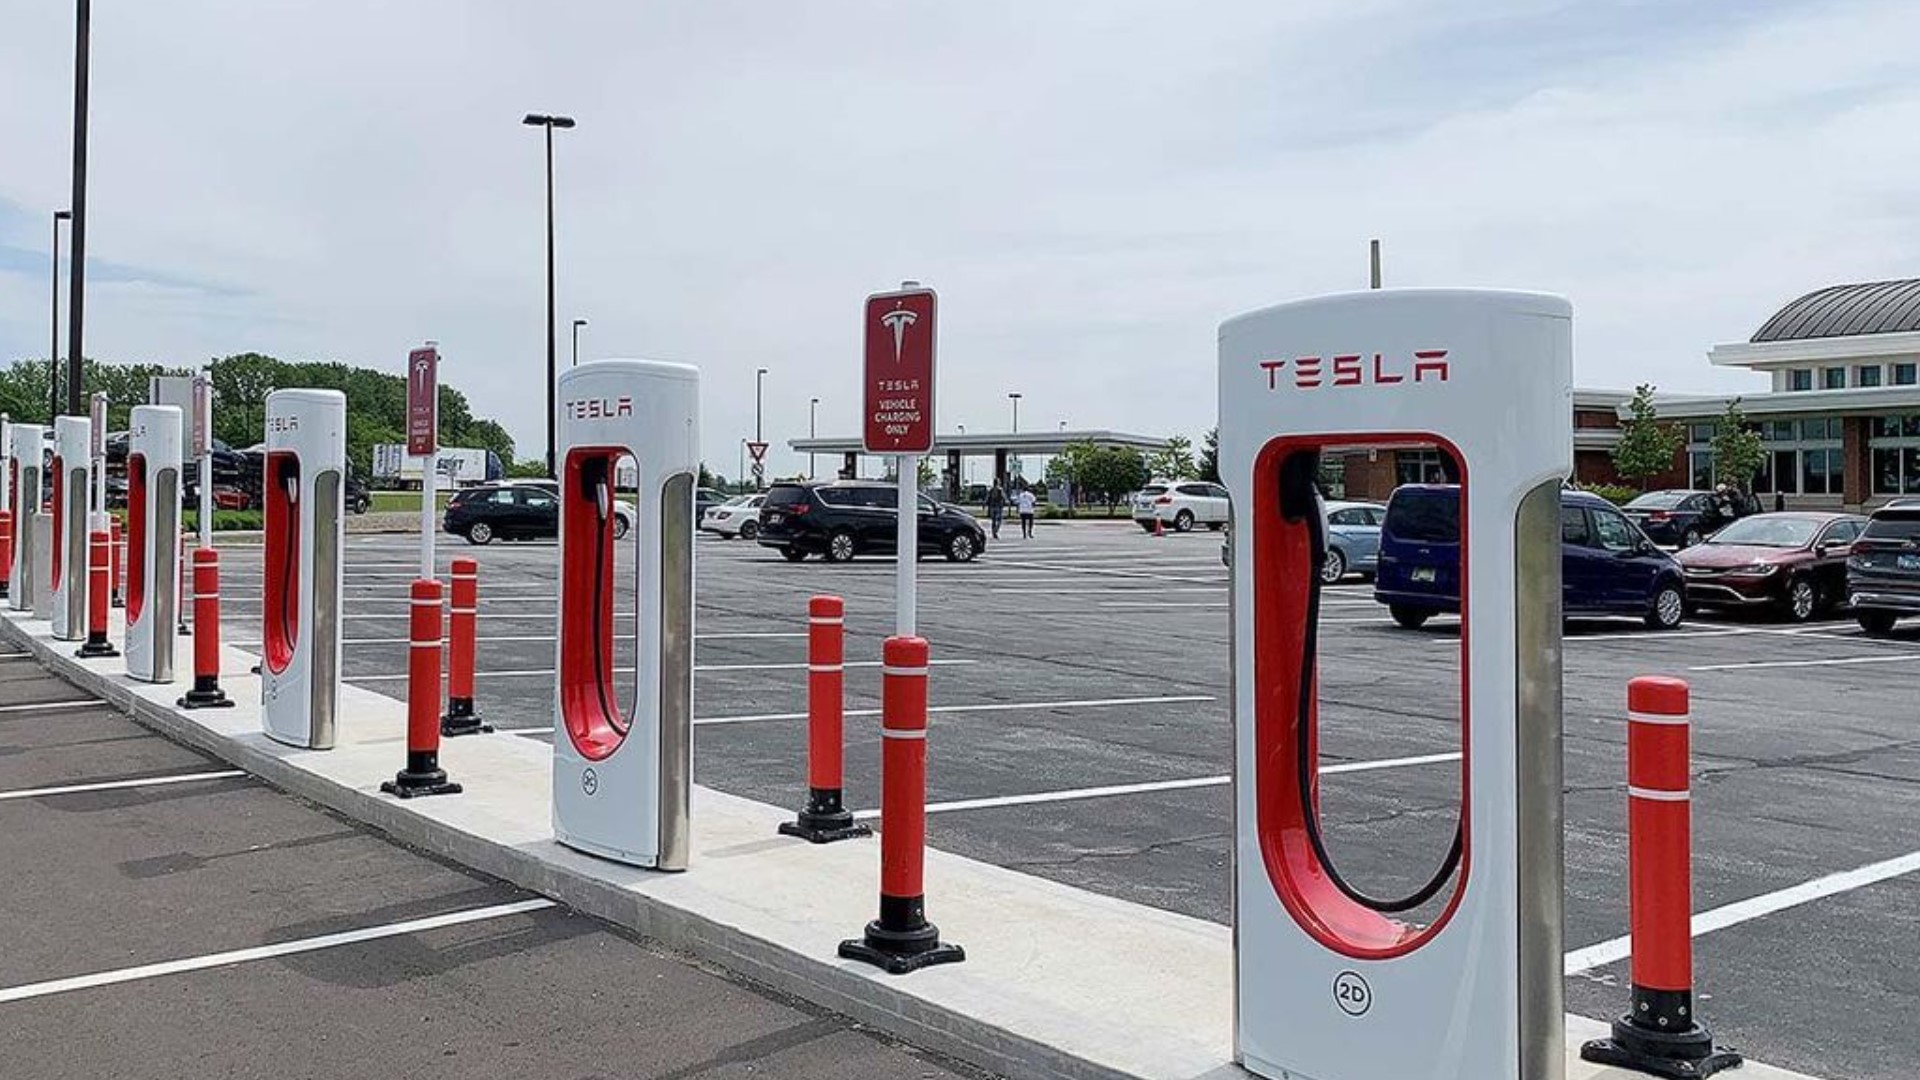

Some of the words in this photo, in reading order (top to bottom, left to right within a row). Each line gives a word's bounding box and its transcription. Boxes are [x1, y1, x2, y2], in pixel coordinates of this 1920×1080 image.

[1260, 350, 1449, 389] TESLA
[878, 380, 919, 391] TESLA
[566, 398, 632, 420] TESLA
[879, 398, 916, 410] VEHICLE
[874, 411, 922, 423] CHARGING
[884, 424, 910, 435] ONLY
[1340, 982, 1365, 1002] 2D
